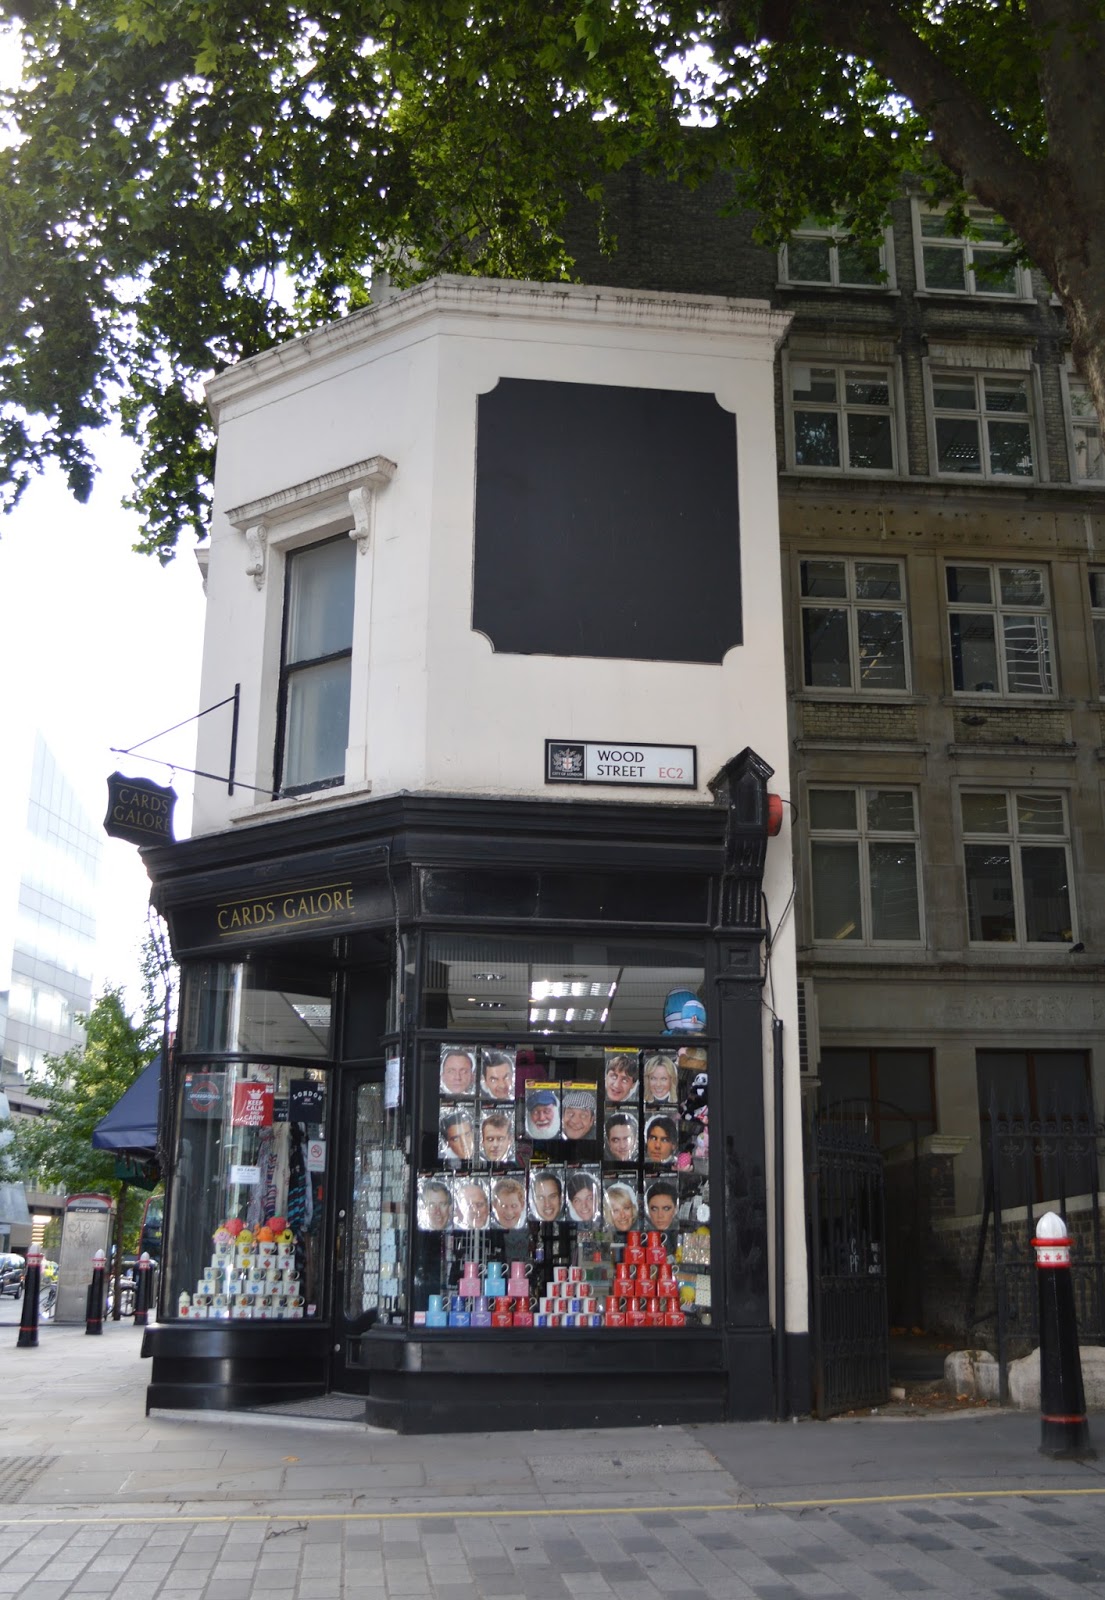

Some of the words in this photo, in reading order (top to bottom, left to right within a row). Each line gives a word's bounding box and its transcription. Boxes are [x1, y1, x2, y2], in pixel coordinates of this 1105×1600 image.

[597, 750, 645, 763] WOOD
[597, 765, 646, 778] STREET
[658, 767, 684, 779] EC2
[118, 788, 169, 814] CARDS
[113, 805, 171, 832] GALORE
[217, 901, 276, 930] CARDS
[283, 888, 355, 917] GALORE
[293, 1090, 323, 1102] LONDON
